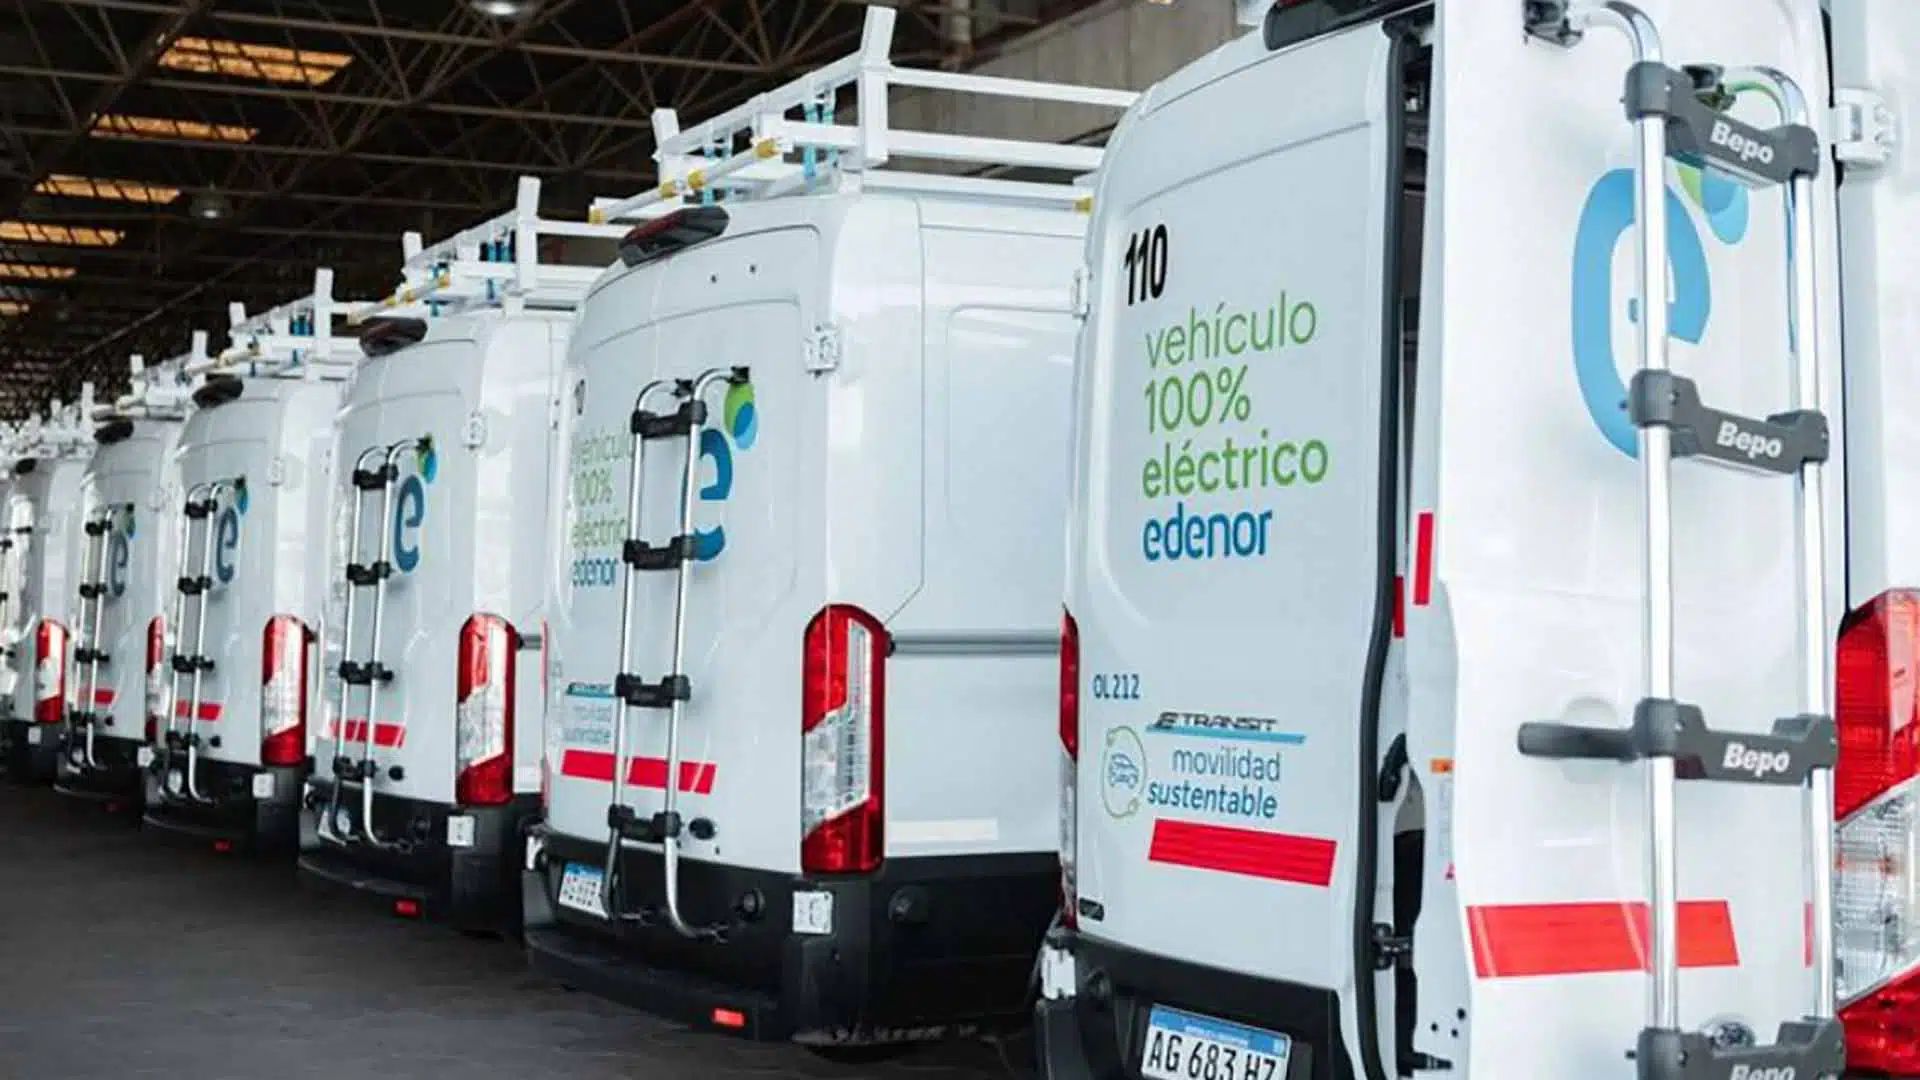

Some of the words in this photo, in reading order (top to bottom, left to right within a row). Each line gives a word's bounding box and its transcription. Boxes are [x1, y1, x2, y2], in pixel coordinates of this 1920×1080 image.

[1709, 120, 1775, 165] Bepo
[1123, 223, 1168, 306] 110
[1146, 289, 1317, 369] vehículo
[1144, 364, 1251, 434] 100%
[1716, 419, 1783, 458] Bepo
[1142, 428, 1328, 499] eléctrico
[1142, 501, 1273, 561] edenor
[1093, 673, 1141, 700] OL212
[1171, 746, 1281, 782] movilidad
[1723, 741, 1791, 778] Bepo
[1147, 780, 1279, 819] sustentable
[1148, 1031, 1183, 1072] AG
[1187, 1040, 1237, 1080] 683
